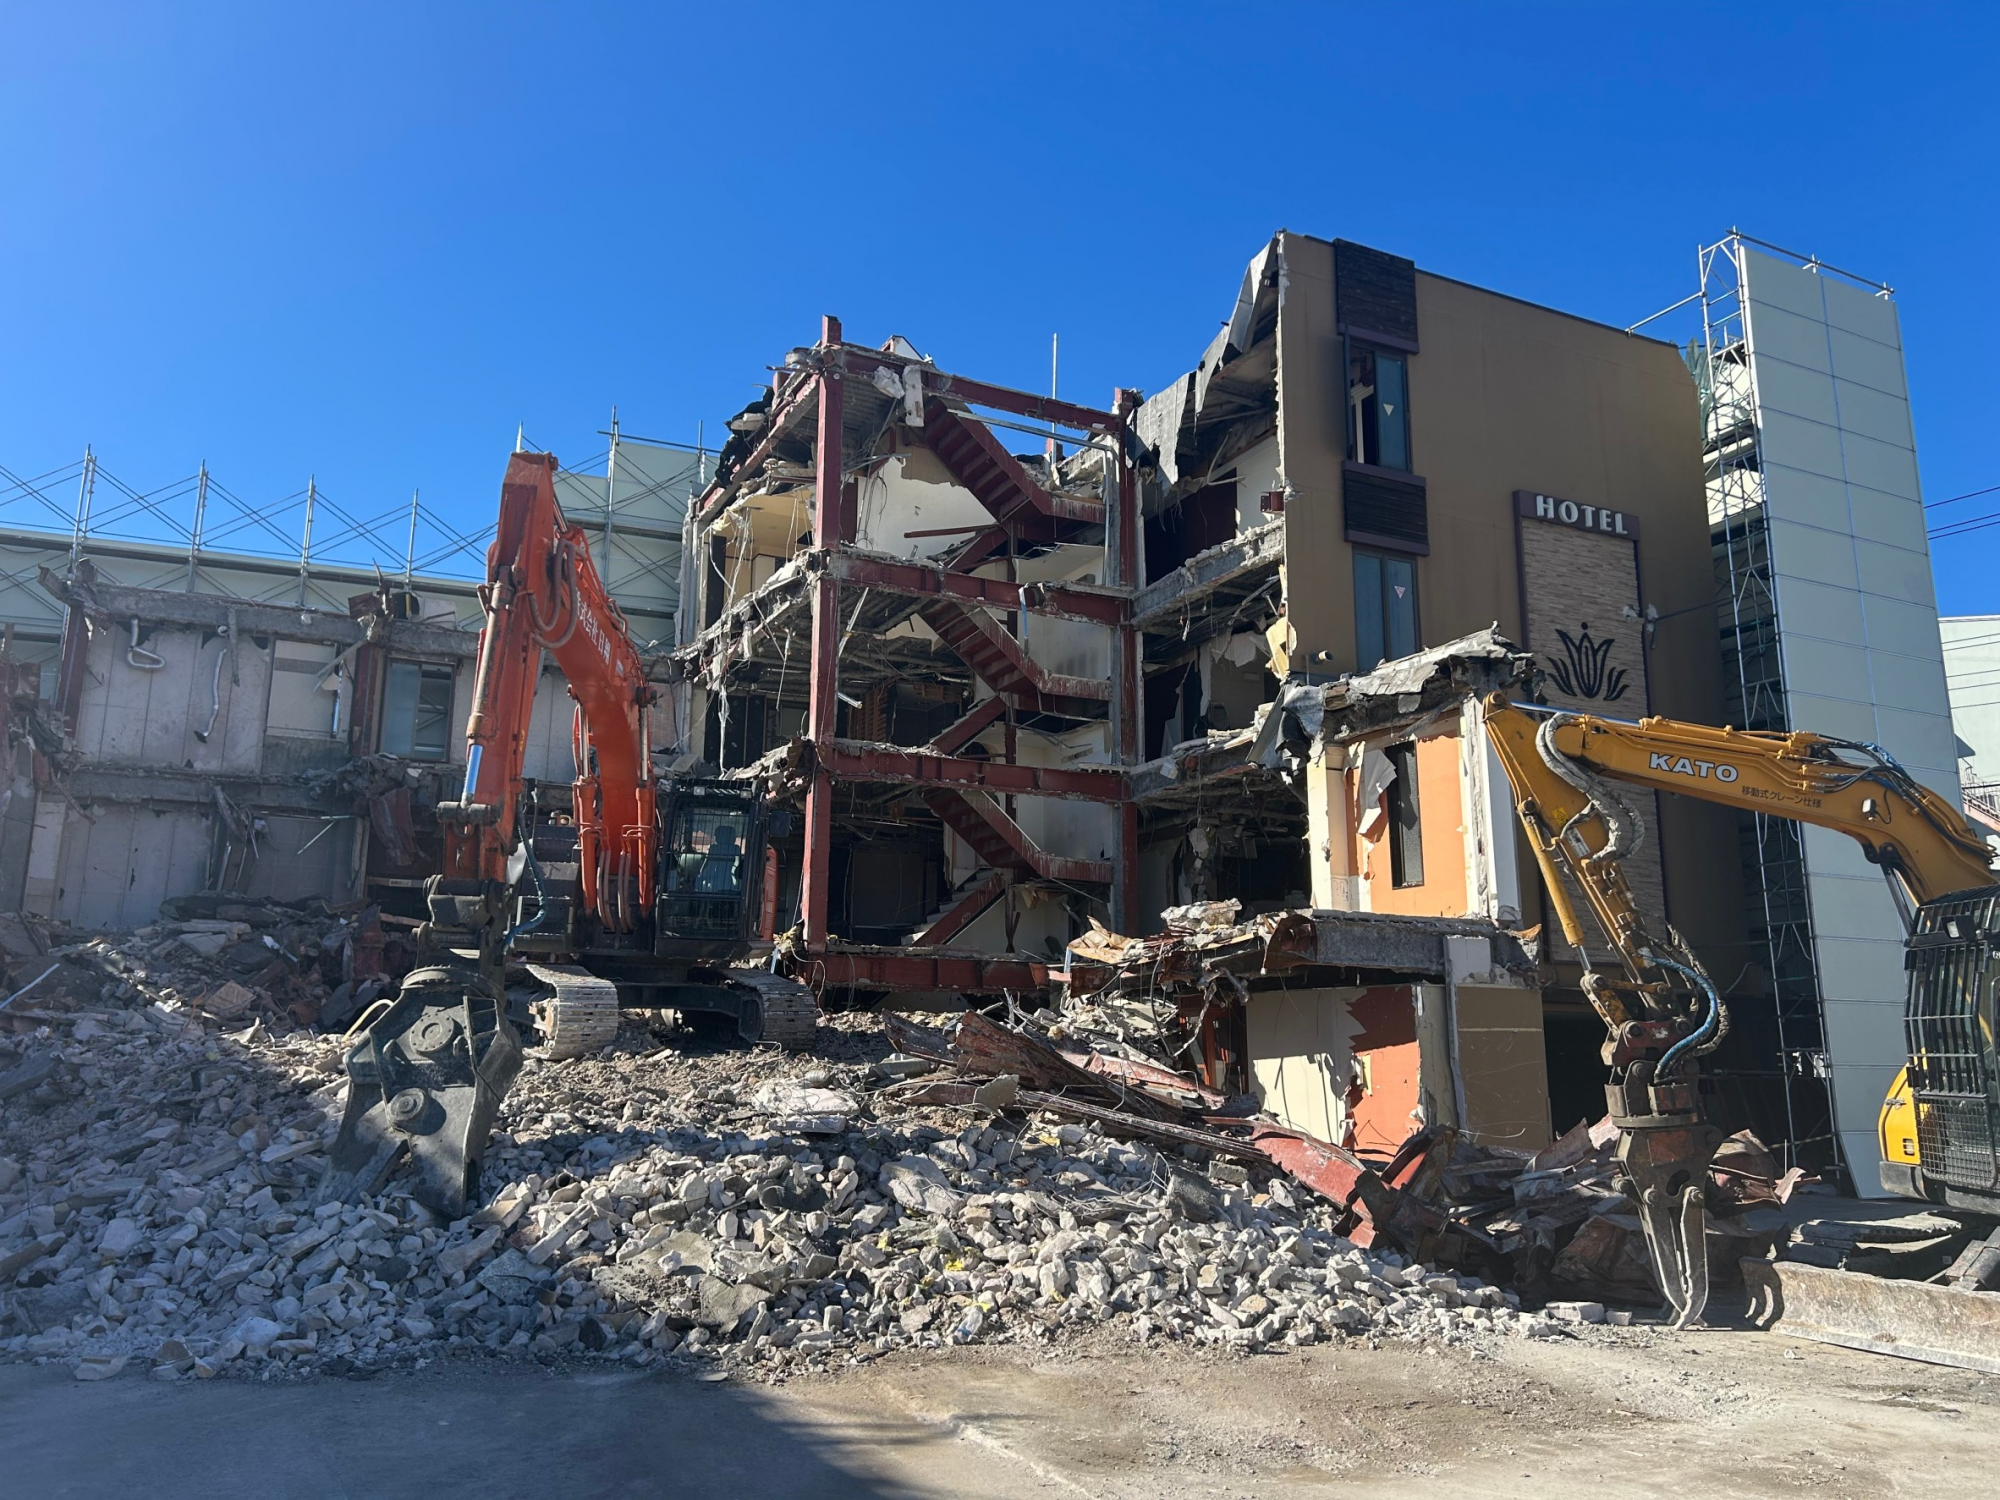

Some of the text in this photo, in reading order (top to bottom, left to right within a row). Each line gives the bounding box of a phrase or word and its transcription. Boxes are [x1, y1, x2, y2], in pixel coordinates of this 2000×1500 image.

[1536, 495, 1628, 535] HOTEL
[1649, 753, 1739, 782] KATO
[1741, 785, 1822, 809] 移動式クレーン仕様
